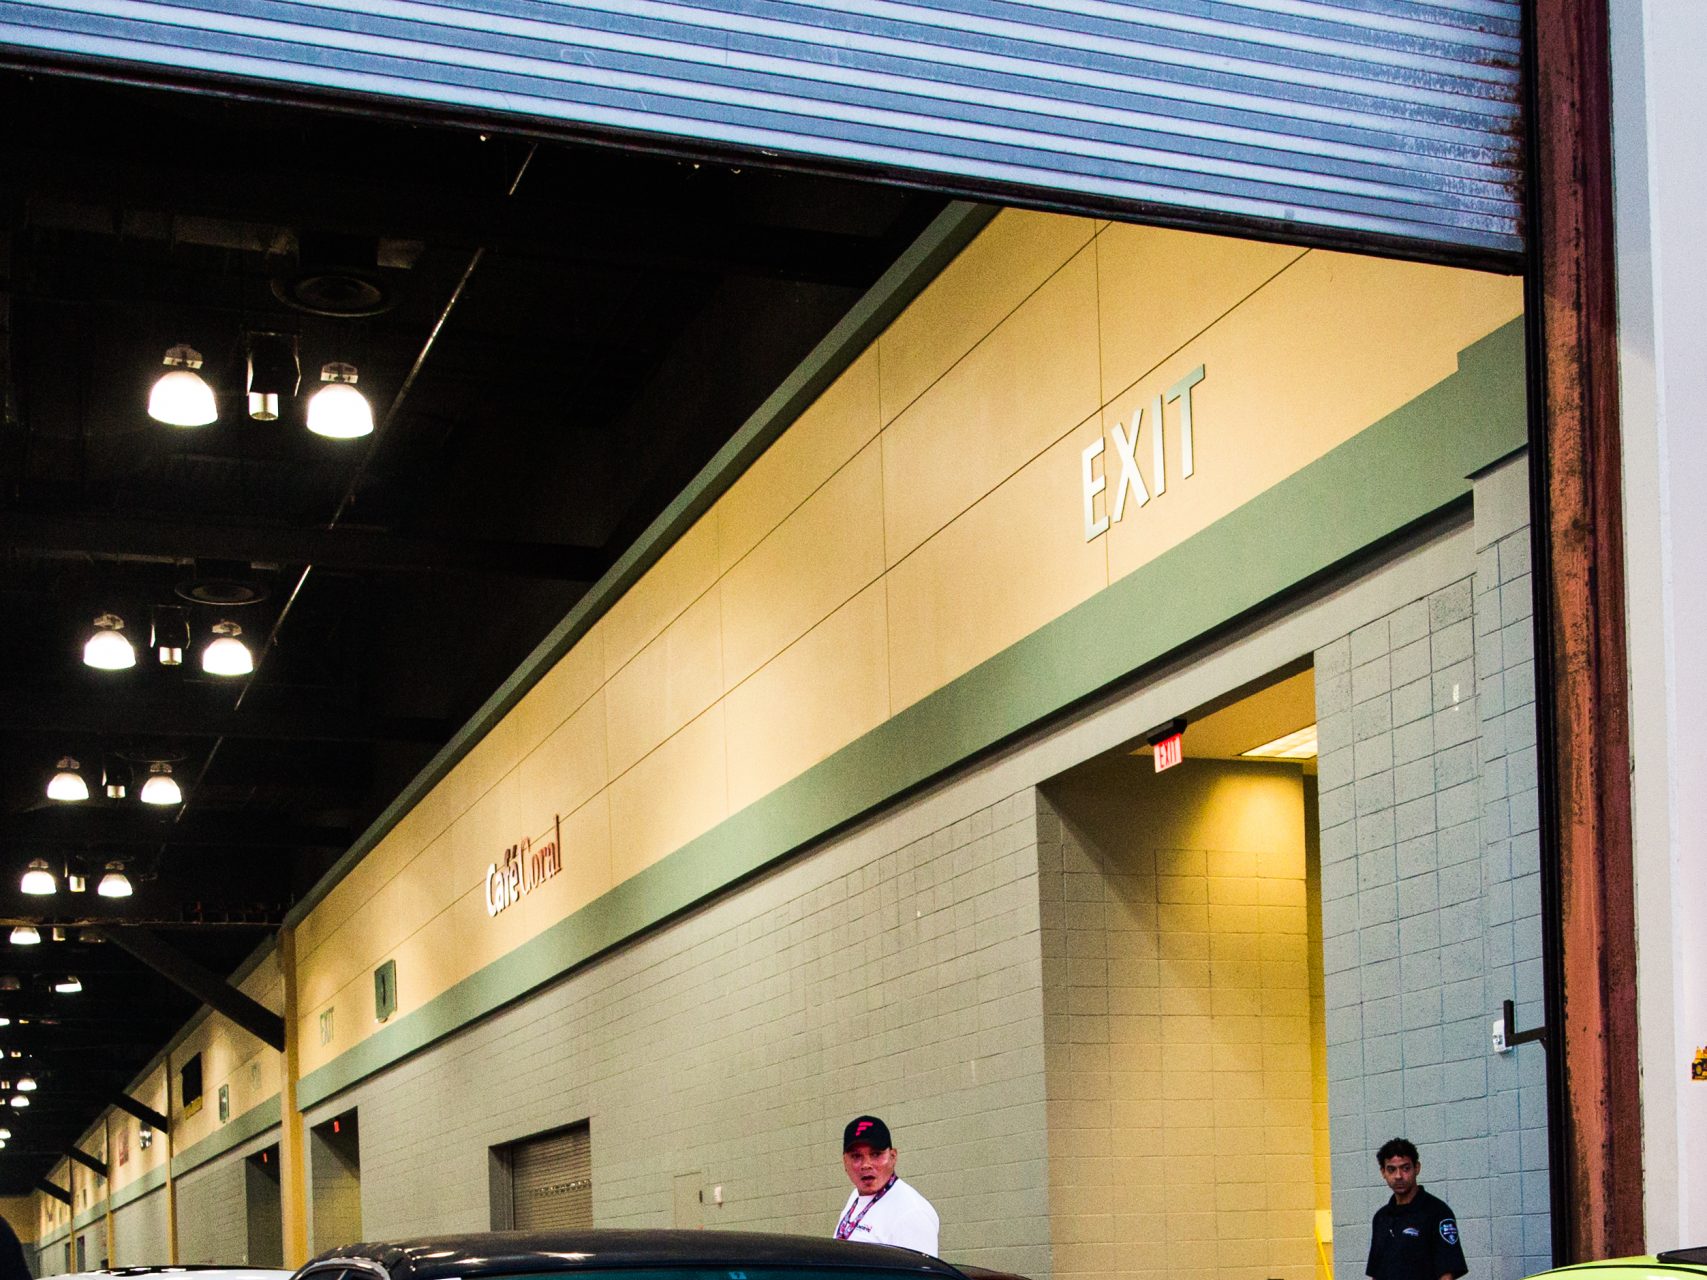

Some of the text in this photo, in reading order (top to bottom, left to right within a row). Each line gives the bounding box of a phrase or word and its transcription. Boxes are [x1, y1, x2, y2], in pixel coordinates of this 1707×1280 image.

[1082, 363, 1206, 543] EXIT
[1158, 737, 1180, 769] EXIT
[486, 814, 562, 917] Café Coral
